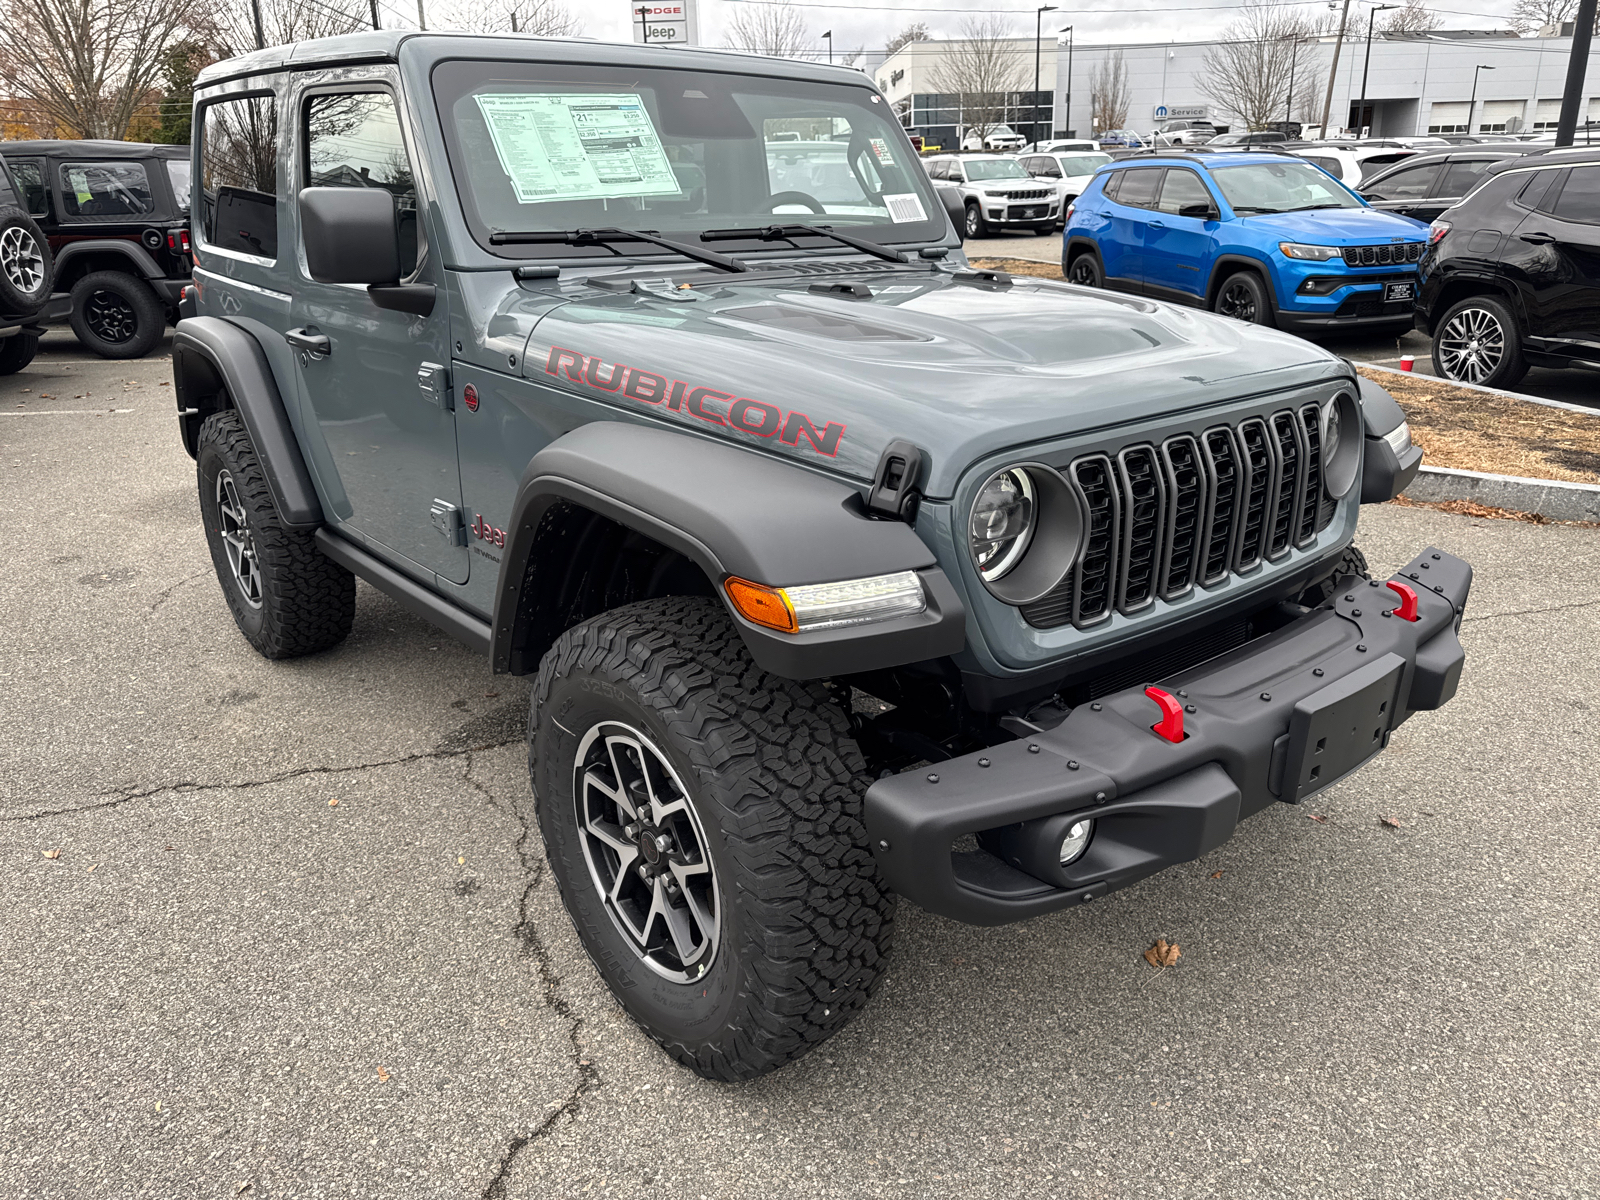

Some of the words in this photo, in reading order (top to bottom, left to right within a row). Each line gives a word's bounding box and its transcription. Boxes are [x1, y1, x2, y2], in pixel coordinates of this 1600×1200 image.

[634, 7, 681, 15] DODGE
[645, 25, 676, 40] Jeep
[576, 113, 588, 122] 21
[1171, 108, 1204, 116] Service
[545, 345, 847, 458] RUBICON
[470, 512, 507, 549] Jee
